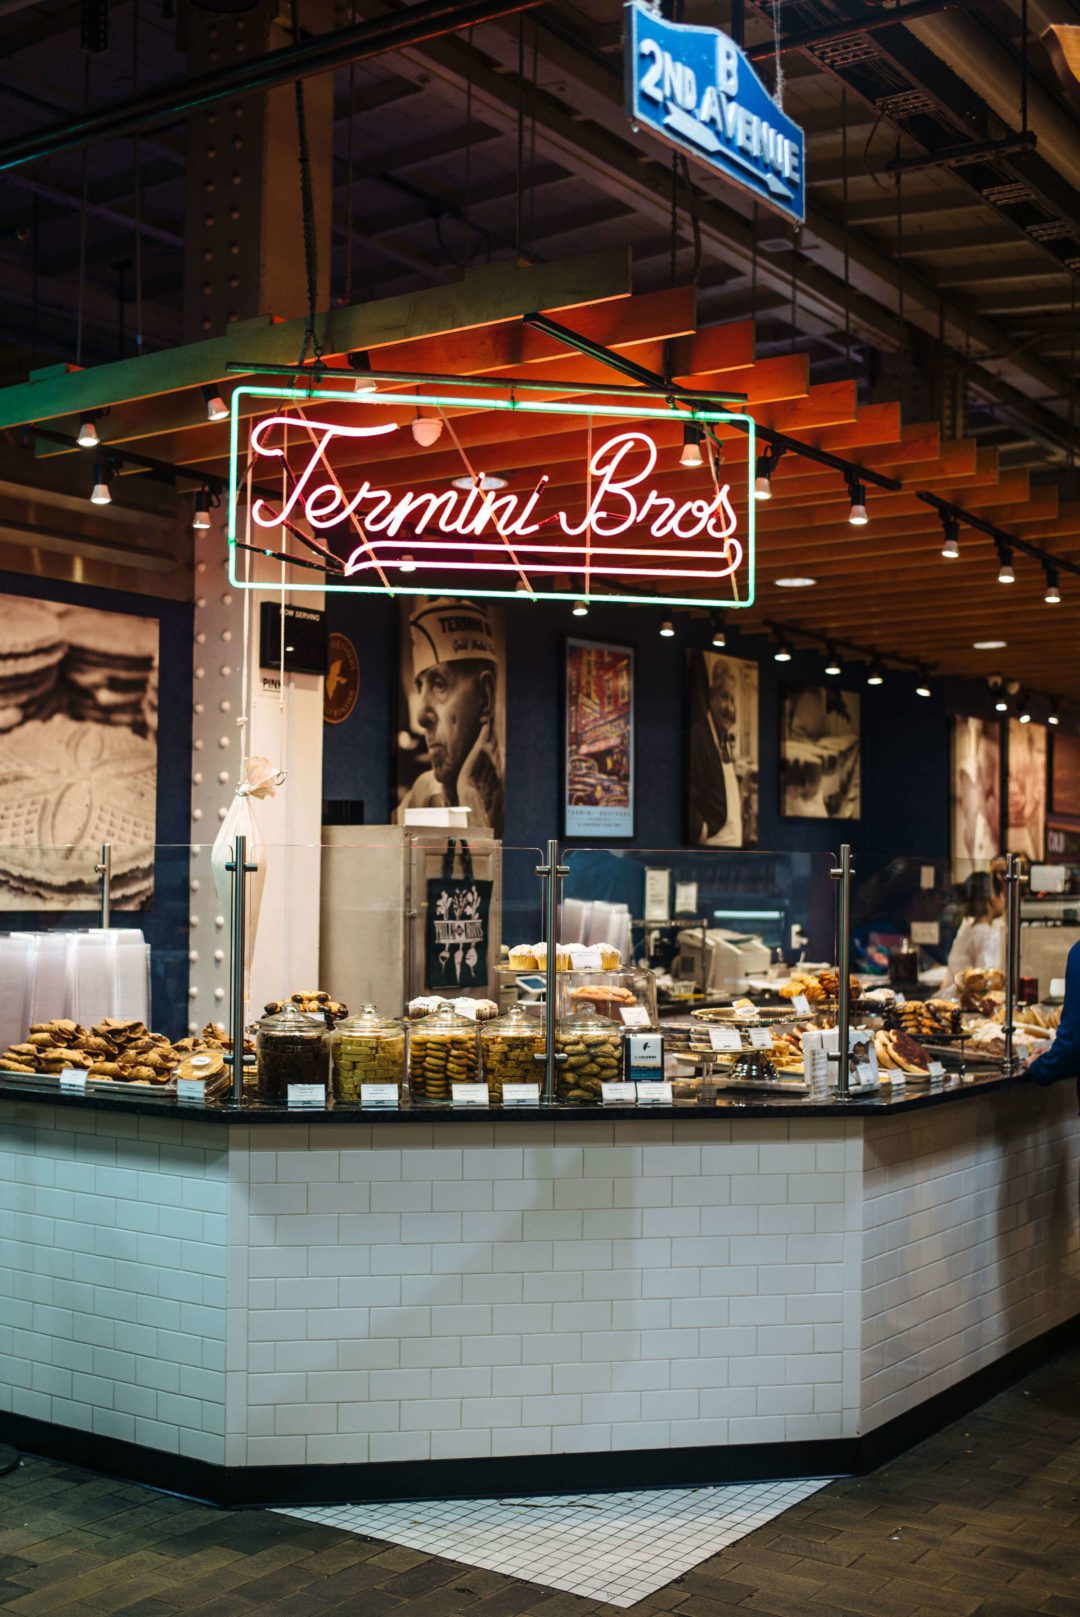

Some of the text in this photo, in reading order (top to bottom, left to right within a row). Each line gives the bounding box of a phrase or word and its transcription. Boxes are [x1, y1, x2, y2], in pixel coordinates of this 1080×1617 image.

[639, 38, 801, 185] 2ND AVENUE
[716, 35, 739, 97] B
[251, 416, 738, 538] Termini Bros
[295, 610, 320, 622] SERVING
